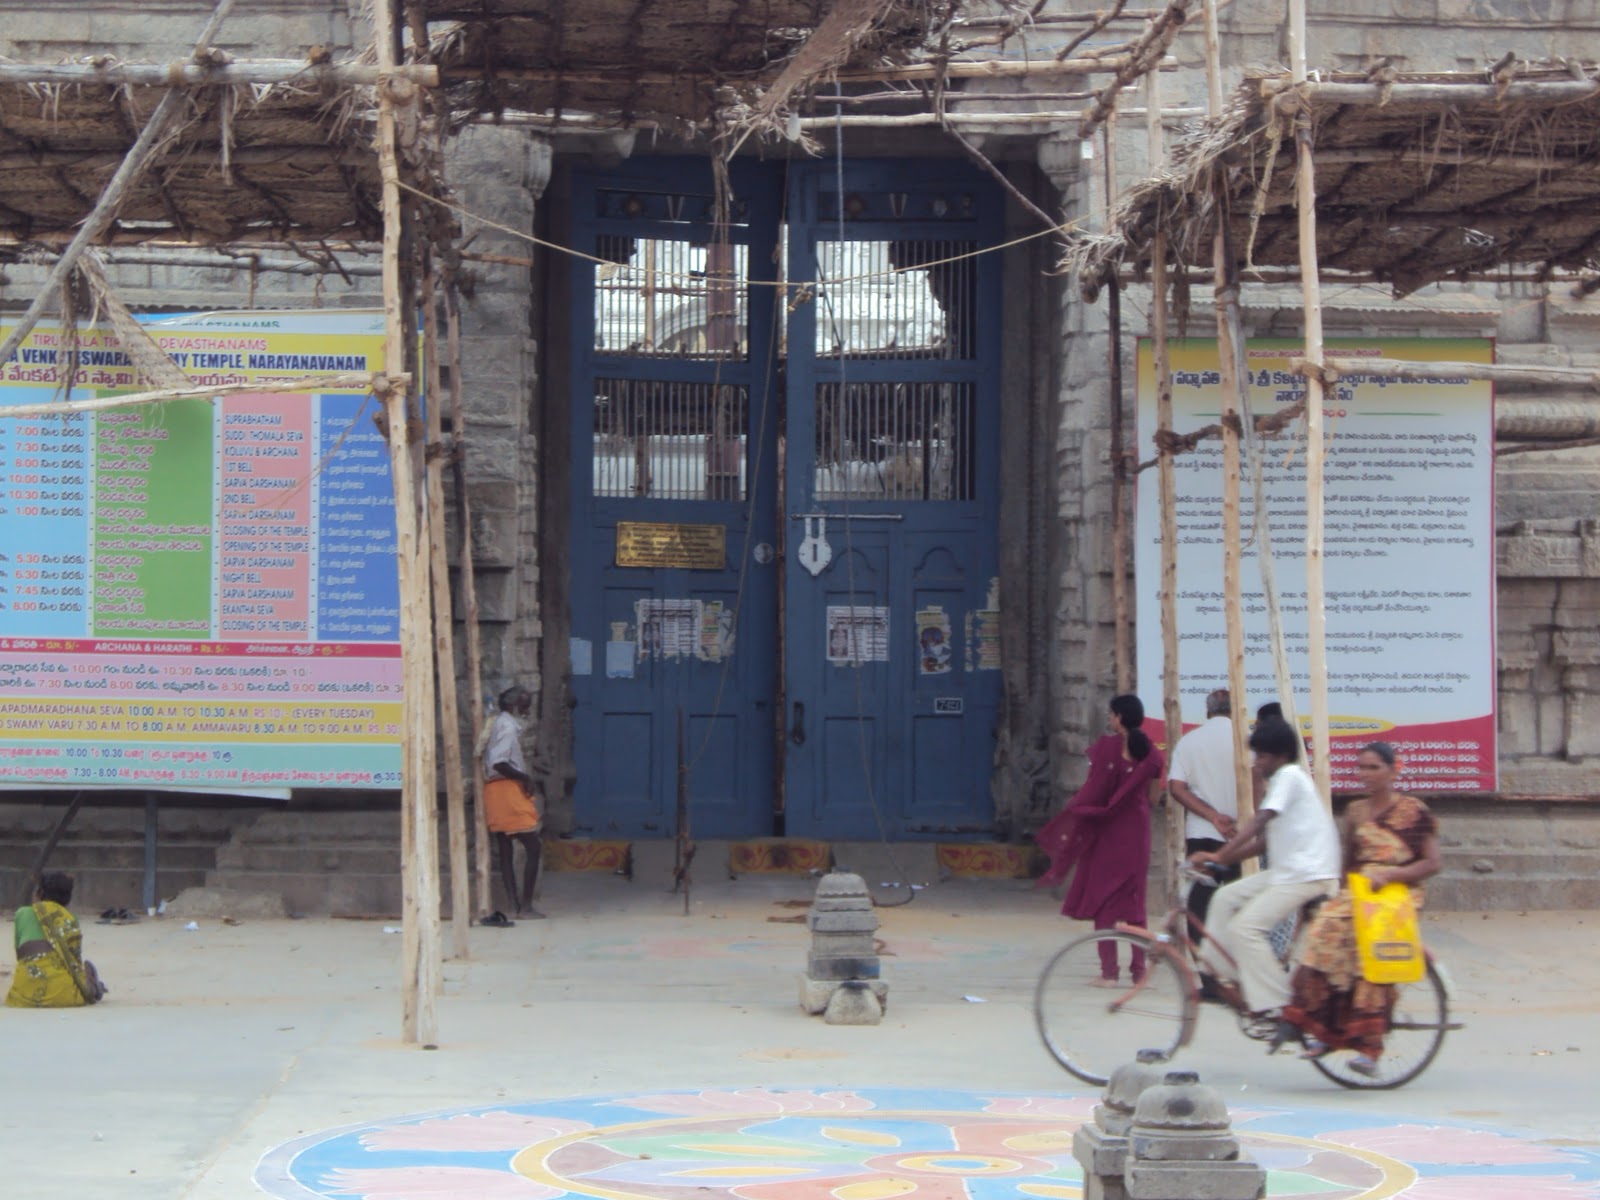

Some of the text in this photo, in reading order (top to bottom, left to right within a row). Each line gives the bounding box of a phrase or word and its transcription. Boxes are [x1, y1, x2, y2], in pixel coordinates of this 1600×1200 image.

[160, 338, 267, 350] DEVASTHANAMS
[22, 350, 132, 366] VENKTESWARA
[248, 354, 366, 371] NARAYANAVANAM
[1176, 370, 1220, 389] పద్మావతి
[1257, 369, 1271, 387] శ్రీ
[225, 415, 282, 425] SUPRABHATHAM
[16, 427, 38, 436] 7.00
[250, 431, 284, 441] THOMALA
[286, 432, 304, 441] SEVA
[16, 443, 38, 452] 7.30
[225, 447, 254, 456] KOLUVU
[262, 447, 299, 457] ARCHANA
[15, 459, 38, 468] 8.00
[225, 462, 252, 472] 1ST BELL
[9, 475, 38, 484] 10.00
[224, 478, 296, 489] SARVA DARSHANAM
[9, 490, 38, 499] 10.30
[224, 494, 255, 504] 2ND BELL
[16, 506, 38, 515] 1.00
[224, 510, 296, 520] SARVA DARSHANAM
[224, 526, 308, 537] CLOSING OF THE TEMPLE
[224, 541, 309, 553] OPENING OF THE TEMPLE
[16, 554, 39, 563] 5.30
[223, 557, 295, 567] SARVA DARSHANAM
[16, 570, 38, 579] 6.30
[222, 573, 261, 583] NIGHT BELL
[16, 586, 38, 595] 7.45
[222, 589, 294, 599] SARVA DARSHANAM
[13, 602, 36, 611] 8.00
[222, 605, 274, 615] EKANTHA SEVA
[222, 620, 307, 631] CLOSING OF THE TEMPLE
[95, 643, 192, 653] ARCHANA & HARATHI
[72, 665, 100, 674] 10.00
[164, 666, 192, 675] 10.30
[39, 679, 61, 688] 7.30
[110, 681, 133, 689] 8.00
[221, 683, 244, 692] 8.30
[292, 684, 314, 692] 9.00
[100, 705, 124, 716] SEVA
[128, 706, 154, 716] 10.00
[183, 707, 196, 717] TO
[200, 707, 225, 717] 10.30
[292, 708, 326, 719] (EVERY
[329, 708, 375, 719] TUESDAY)
[6, 719, 44, 730] SWAMY
[47, 720, 74, 730] VARU
[77, 721, 97, 731] 7.30
[126, 721, 139, 732] TO
[142, 722, 163, 732] 8.00
[192, 723, 250, 734] AMMAVARU
[254, 723, 275, 734] 8.30
[303, 724, 316, 734] TO
[318, 724, 340, 734] 9.00
[66, 748, 87, 758] 10.00
[101, 748, 123, 758] 10.30
[74, 768, 91, 778] 7.30
[99, 769, 117, 778] 8.00
